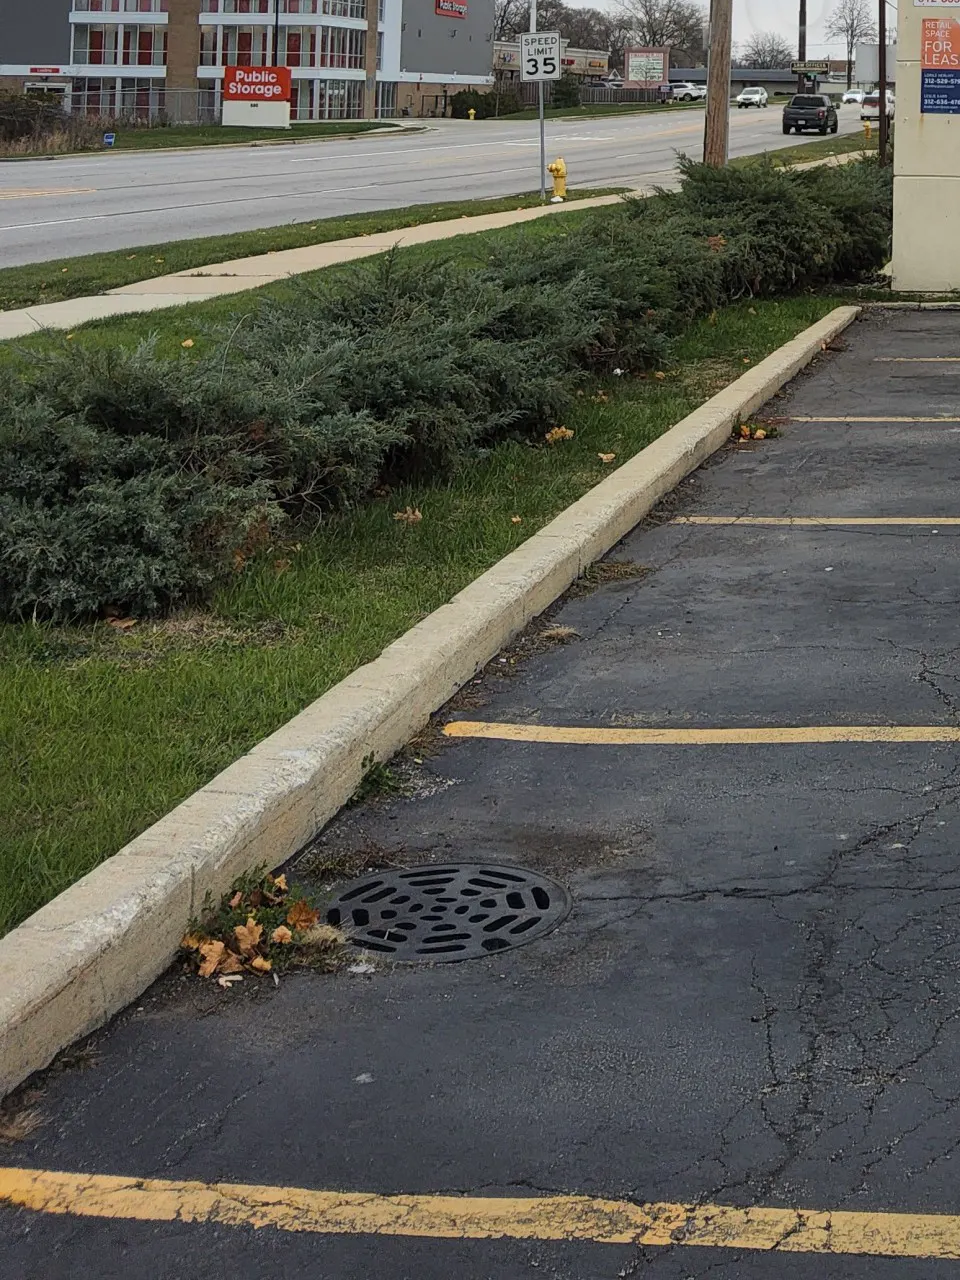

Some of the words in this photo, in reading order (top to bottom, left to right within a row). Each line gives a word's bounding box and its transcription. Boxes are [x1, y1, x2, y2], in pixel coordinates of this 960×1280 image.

[440, 0, 453, 11] Public
[925, 21, 952, 29] RETAIL
[925, 29, 950, 38] SPACE
[524, 37, 558, 46] SPEED
[924, 40, 953, 53] FOR
[527, 47, 554, 56] LIMIT
[525, 57, 556, 76] 35
[235, 70, 278, 83] Public
[228, 82, 283, 97] Storage
